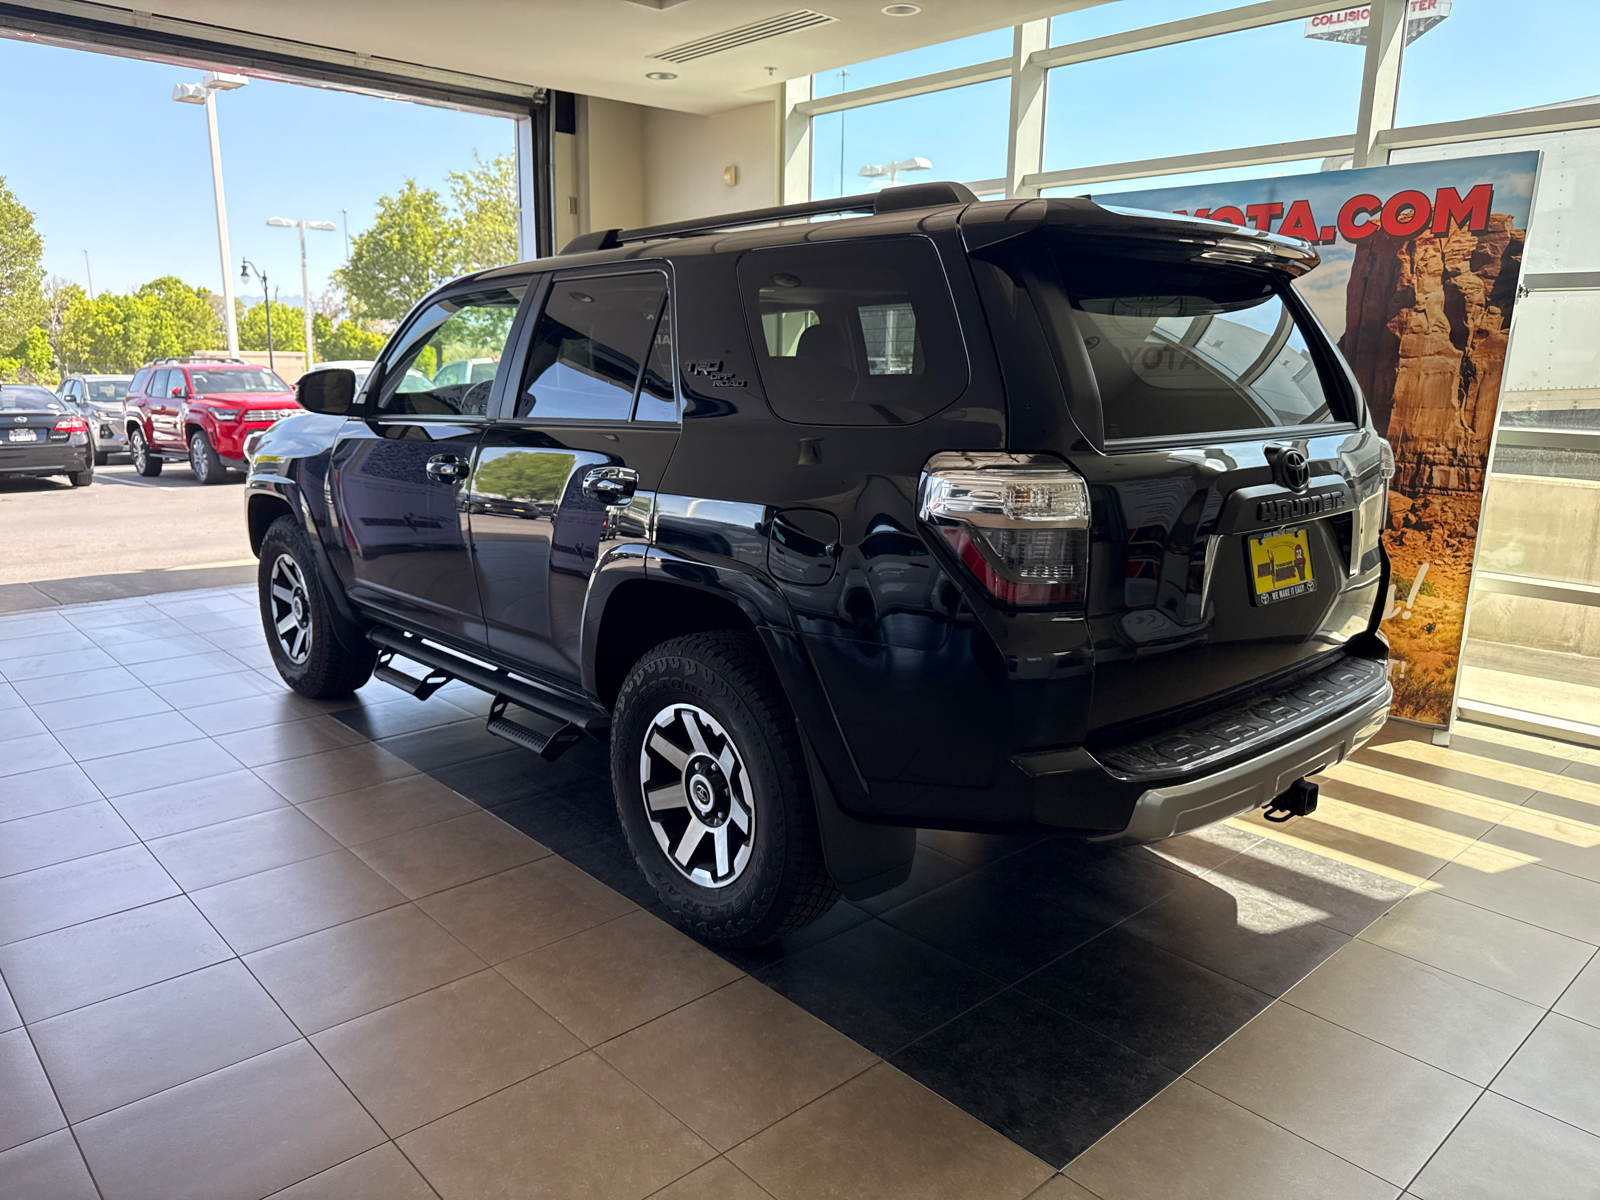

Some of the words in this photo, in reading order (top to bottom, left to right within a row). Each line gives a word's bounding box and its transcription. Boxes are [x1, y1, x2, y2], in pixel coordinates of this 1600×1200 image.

[1311, 8, 1370, 27] COLLISIO
[1410, 0, 1437, 12] TER
[1123, 343, 1201, 370] YOTA
[686, 359, 721, 376] TRD
[713, 380, 746, 388] ROAD
[1296, 549, 1303, 559] 32
[1271, 592, 1279, 601] WE
[1279, 588, 1291, 599] MAKE
[1290, 587, 1295, 595] IT
[1295, 584, 1304, 594] EASY
